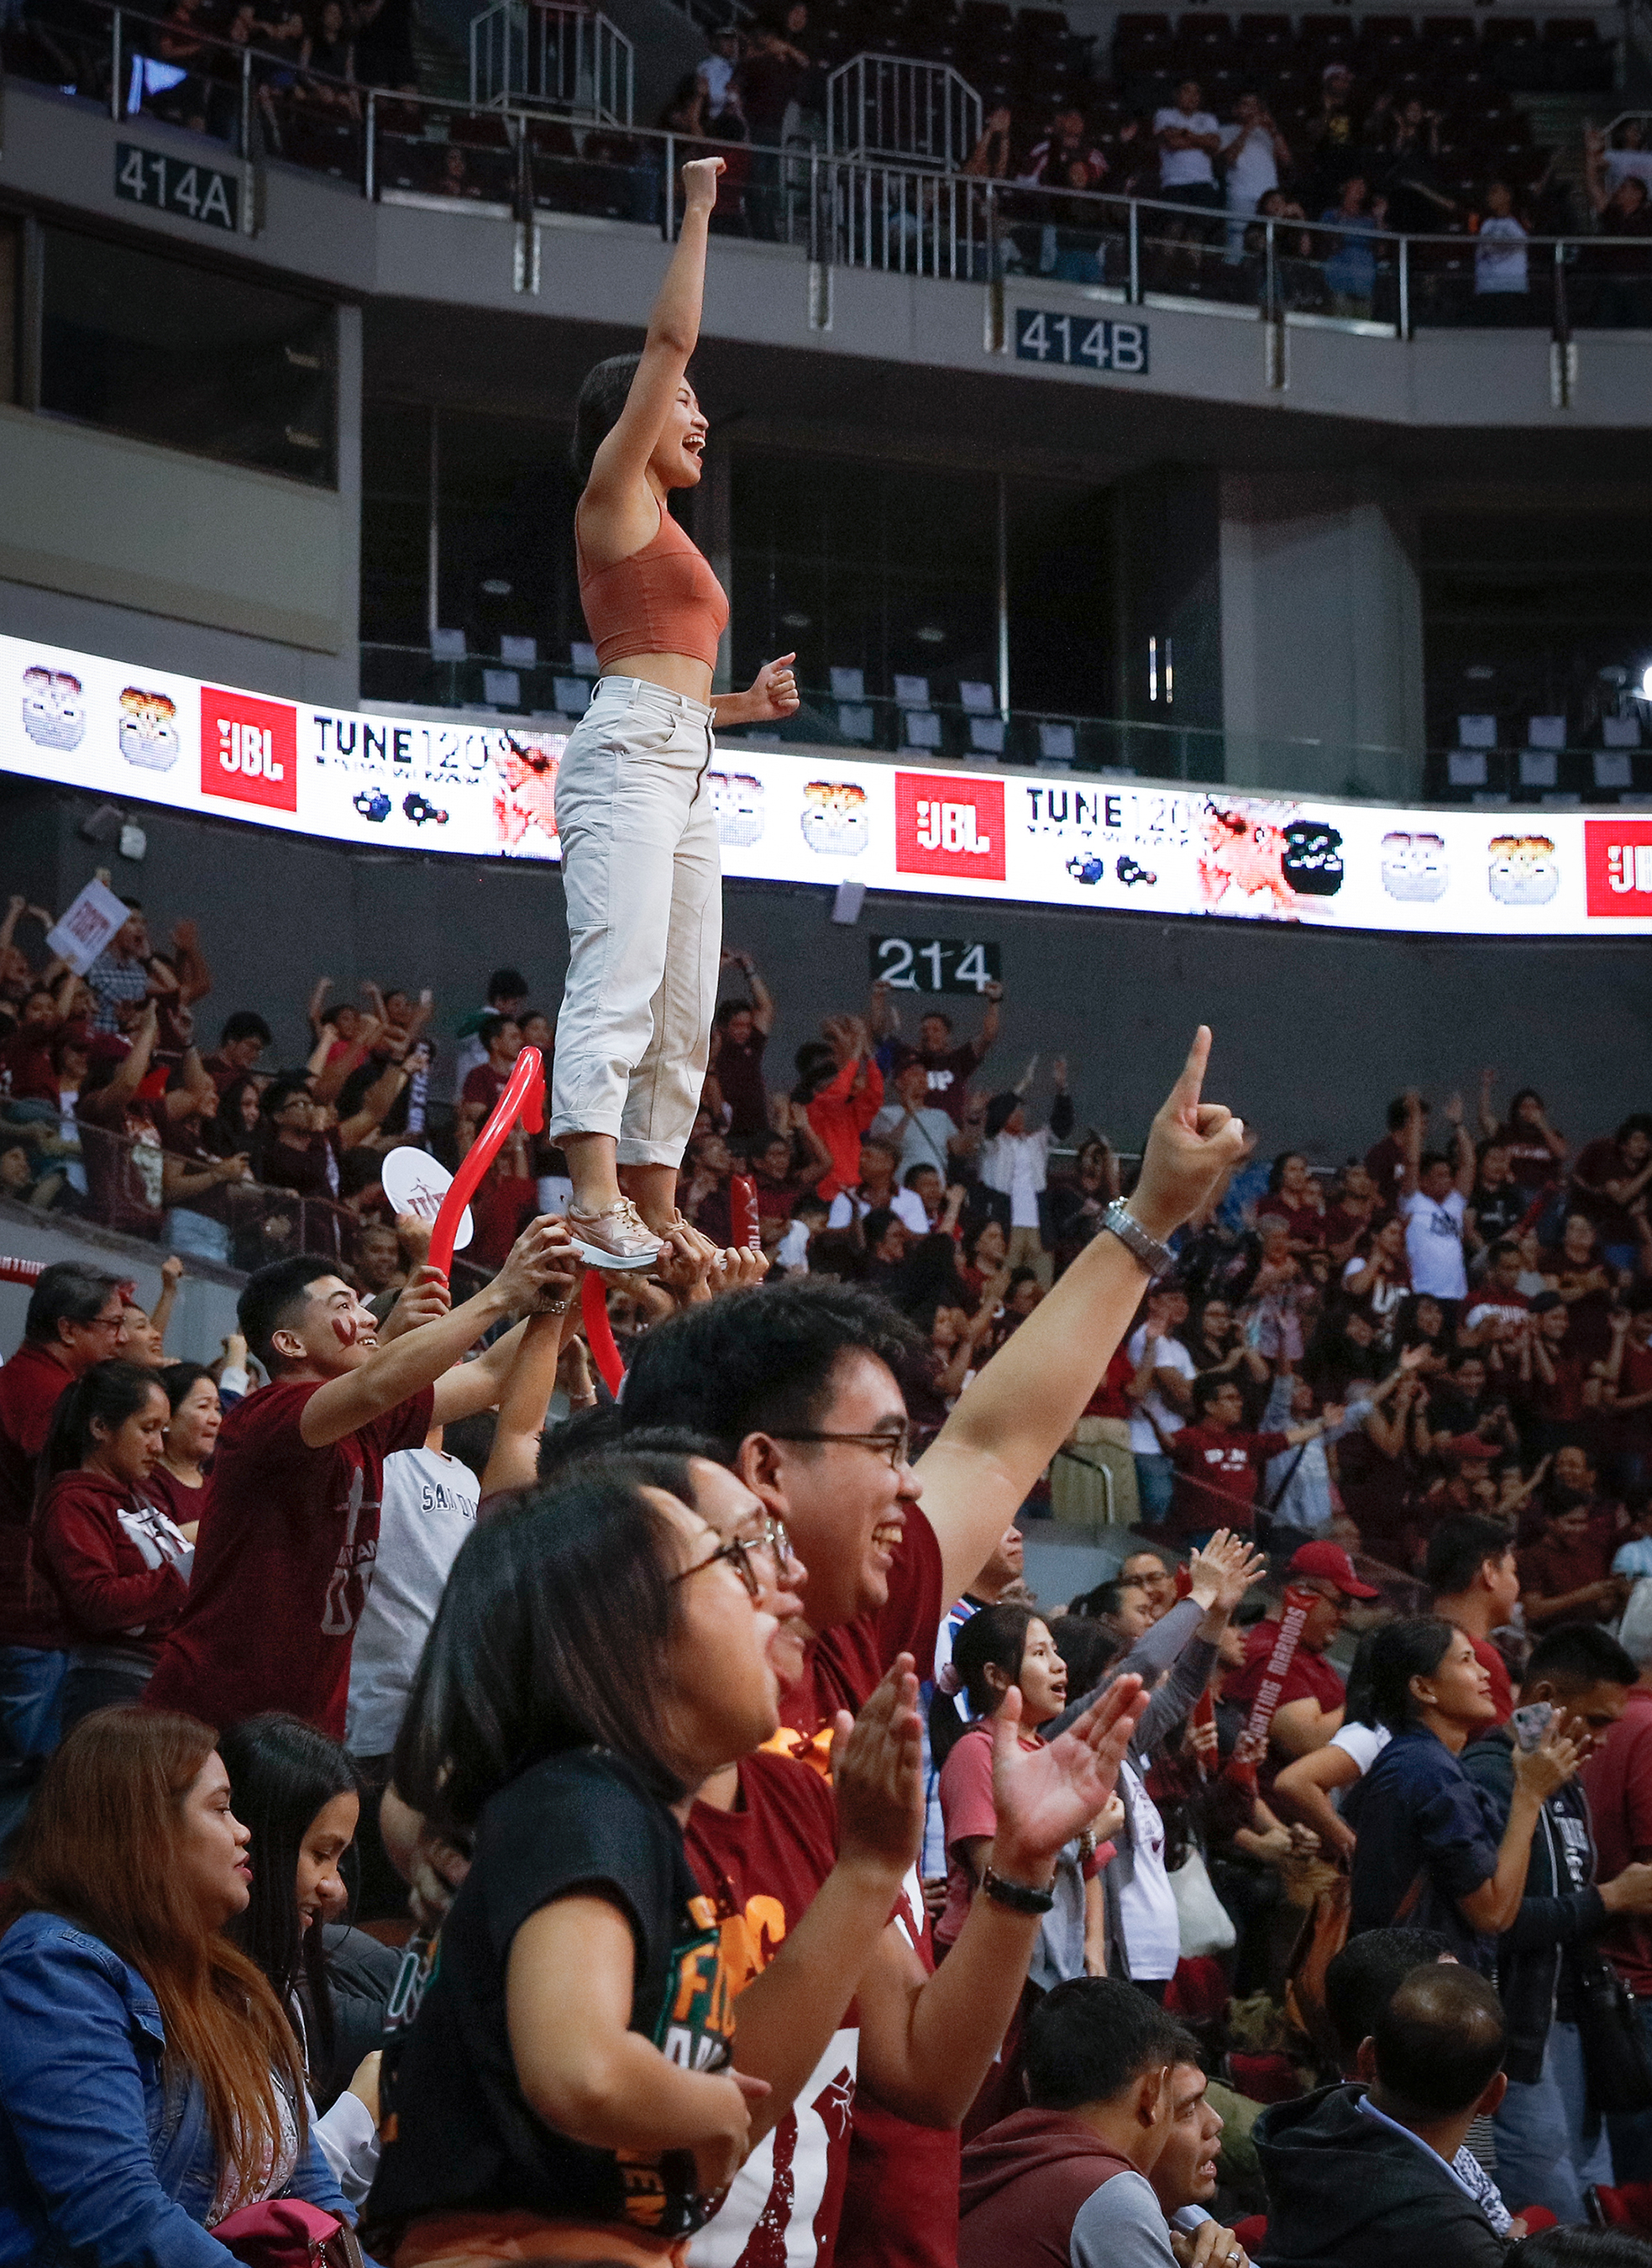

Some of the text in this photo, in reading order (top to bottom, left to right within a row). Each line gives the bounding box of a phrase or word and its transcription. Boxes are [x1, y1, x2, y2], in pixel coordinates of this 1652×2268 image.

[119, 150, 232, 228] 414A
[1020, 312, 1145, 371] 414B
[217, 718, 284, 782] JBL
[916, 800, 990, 854] JBL
[1607, 845, 1652, 894] JB
[878, 937, 993, 993] 214
[1267, 1605, 1308, 1677] MAROONS
